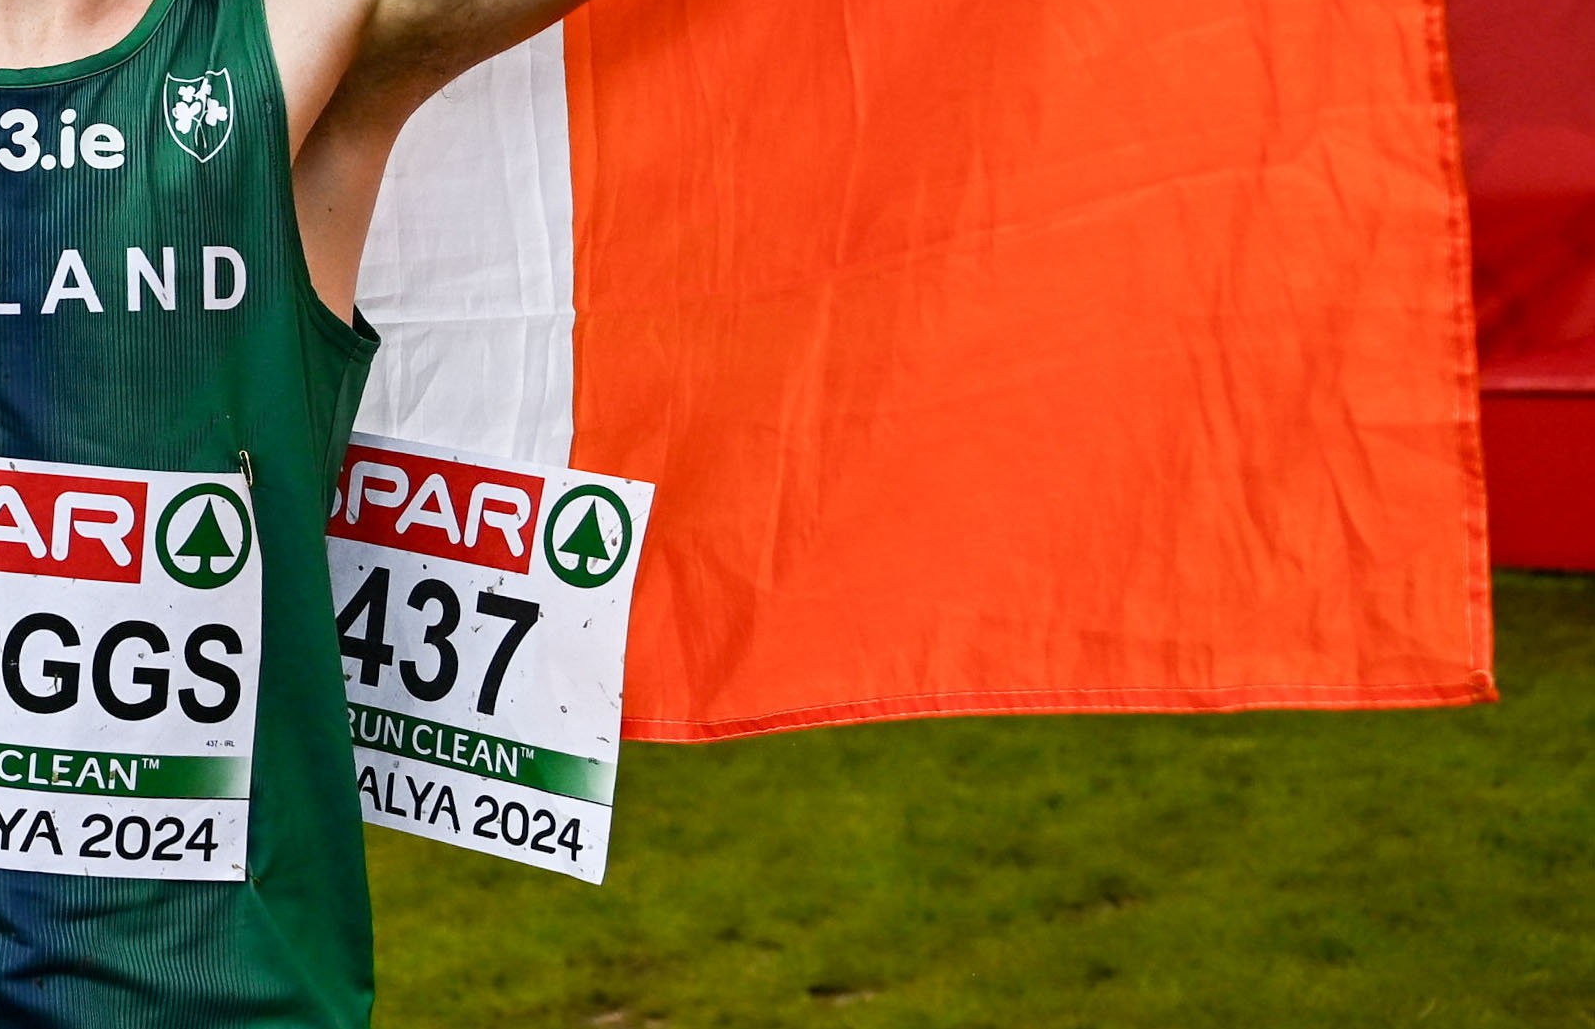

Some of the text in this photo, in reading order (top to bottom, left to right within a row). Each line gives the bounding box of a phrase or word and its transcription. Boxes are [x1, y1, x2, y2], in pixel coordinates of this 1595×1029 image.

[335, 566, 540, 716] 437
[79, 813, 219, 862] 2024
[473, 795, 583, 861] 2024
